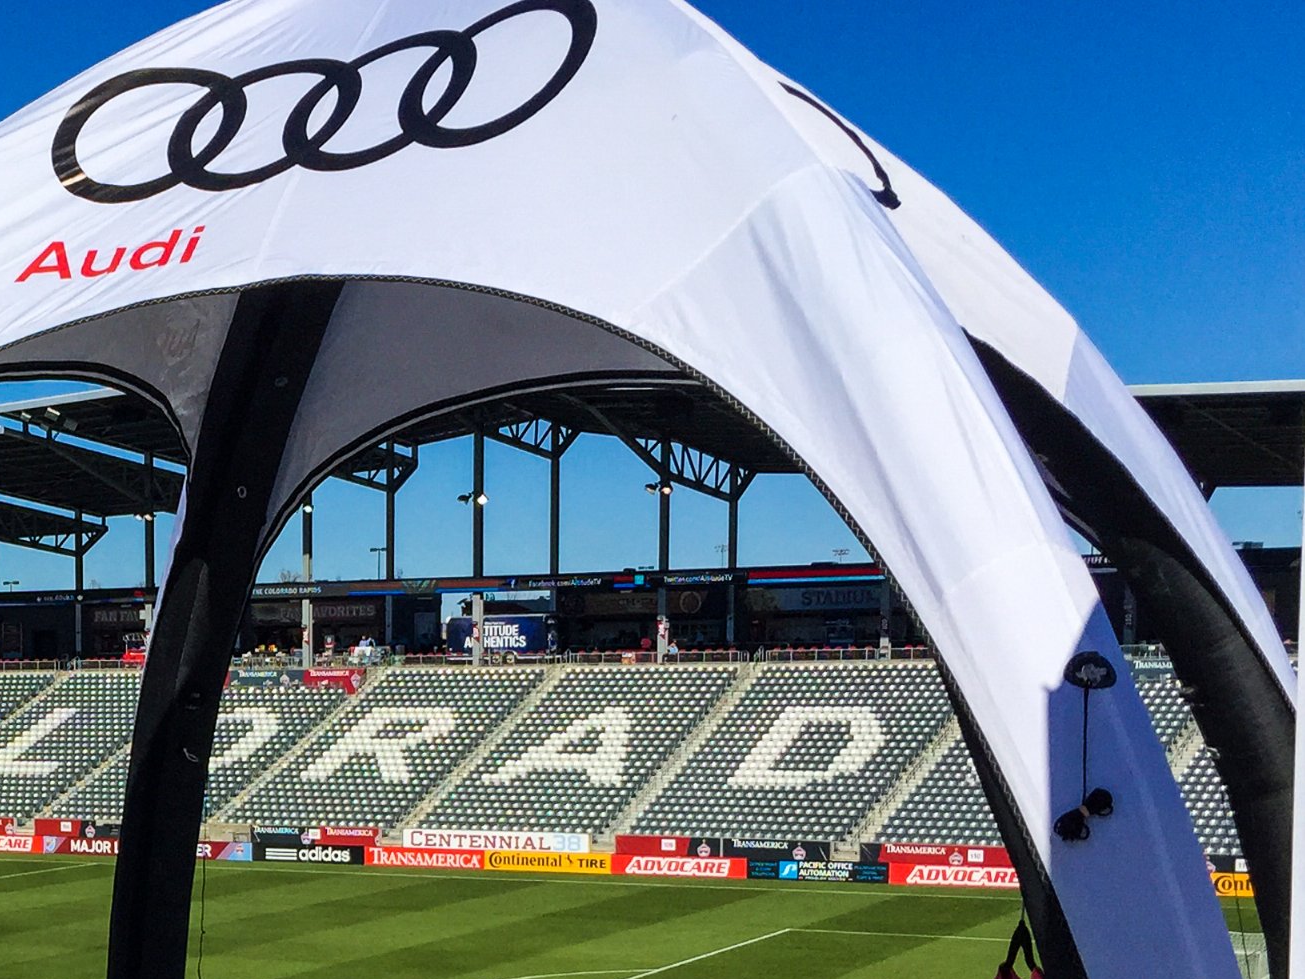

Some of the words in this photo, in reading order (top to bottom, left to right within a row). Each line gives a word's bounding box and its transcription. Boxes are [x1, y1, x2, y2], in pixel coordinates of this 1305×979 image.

[14, 225, 206, 283] Audi
[314, 605, 376, 617] AVORITES
[484, 624, 520, 637] TITUDE
[464, 636, 527, 648] AHENTICS
[325, 827, 373, 837] TRANSAMERICA
[70, 840, 112, 854] MAJOR
[410, 830, 551, 851] CENTENNIAL
[552, 834, 581, 851] 38
[732, 838, 788, 850] TRANSAMERICA
[298, 847, 350, 862] adidas
[885, 844, 946, 855] TRANSAMERICA
[369, 848, 482, 868] TRANSAMERICA
[489, 851, 562, 868] Continental
[578, 858, 607, 869] TIRE
[627, 857, 730, 877] ADVOCARE
[799, 861, 826, 870] PACIFIC
[827, 862, 853, 871] OFFICE
[799, 869, 849, 878] AUTOMATION
[907, 866, 1020, 885] ADVOCARE
